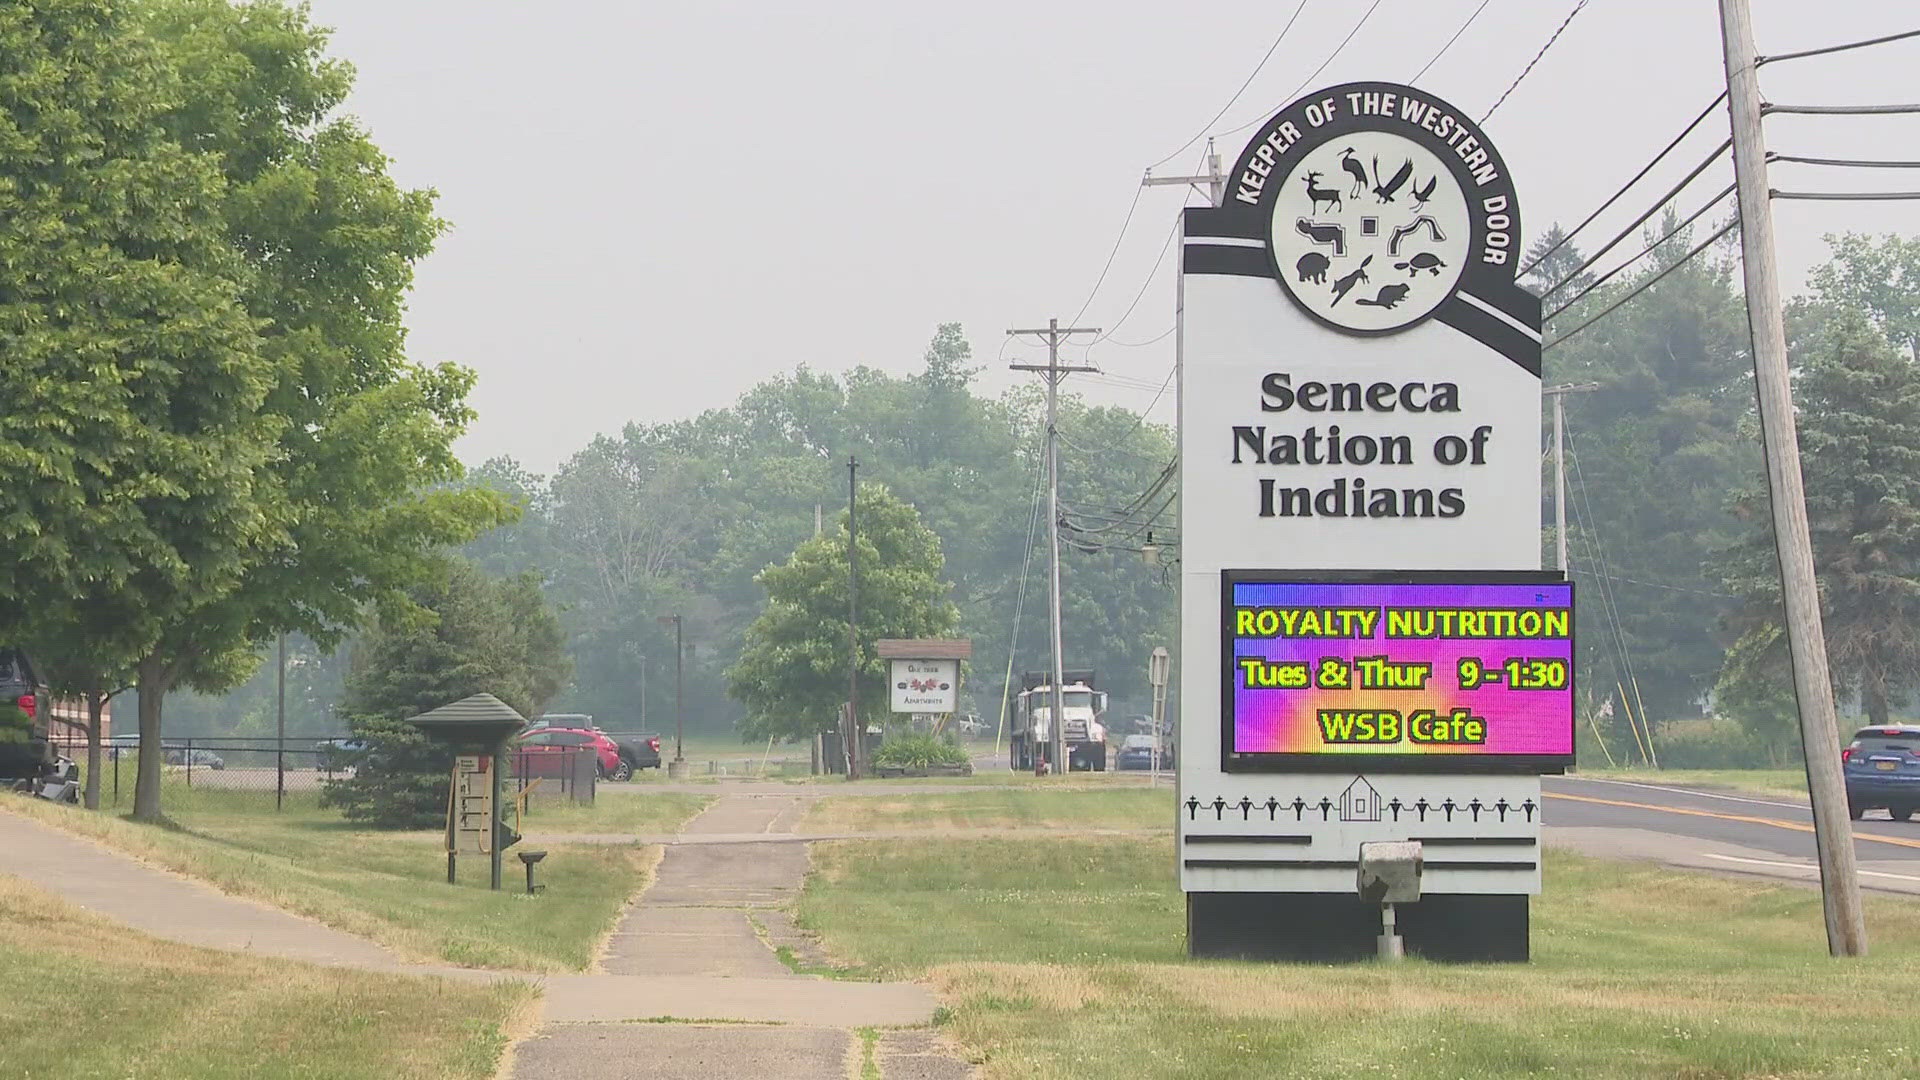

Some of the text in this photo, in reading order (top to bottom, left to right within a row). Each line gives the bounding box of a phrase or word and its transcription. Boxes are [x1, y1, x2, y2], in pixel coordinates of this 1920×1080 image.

[1236, 92, 1511, 266] KEEPER OF THE WESTERN DOOR
[1261, 372, 1462, 413] Seneca
[1231, 425, 1493, 466] Nation of
[1259, 477, 1466, 519] Indians
[1236, 610, 1569, 637] ROYALTY NUTRITION
[1241, 660, 1307, 687] Tues
[1319, 660, 1348, 687] &
[1358, 659, 1428, 687] Thur
[1320, 711, 1483, 742] WSB Cafe
